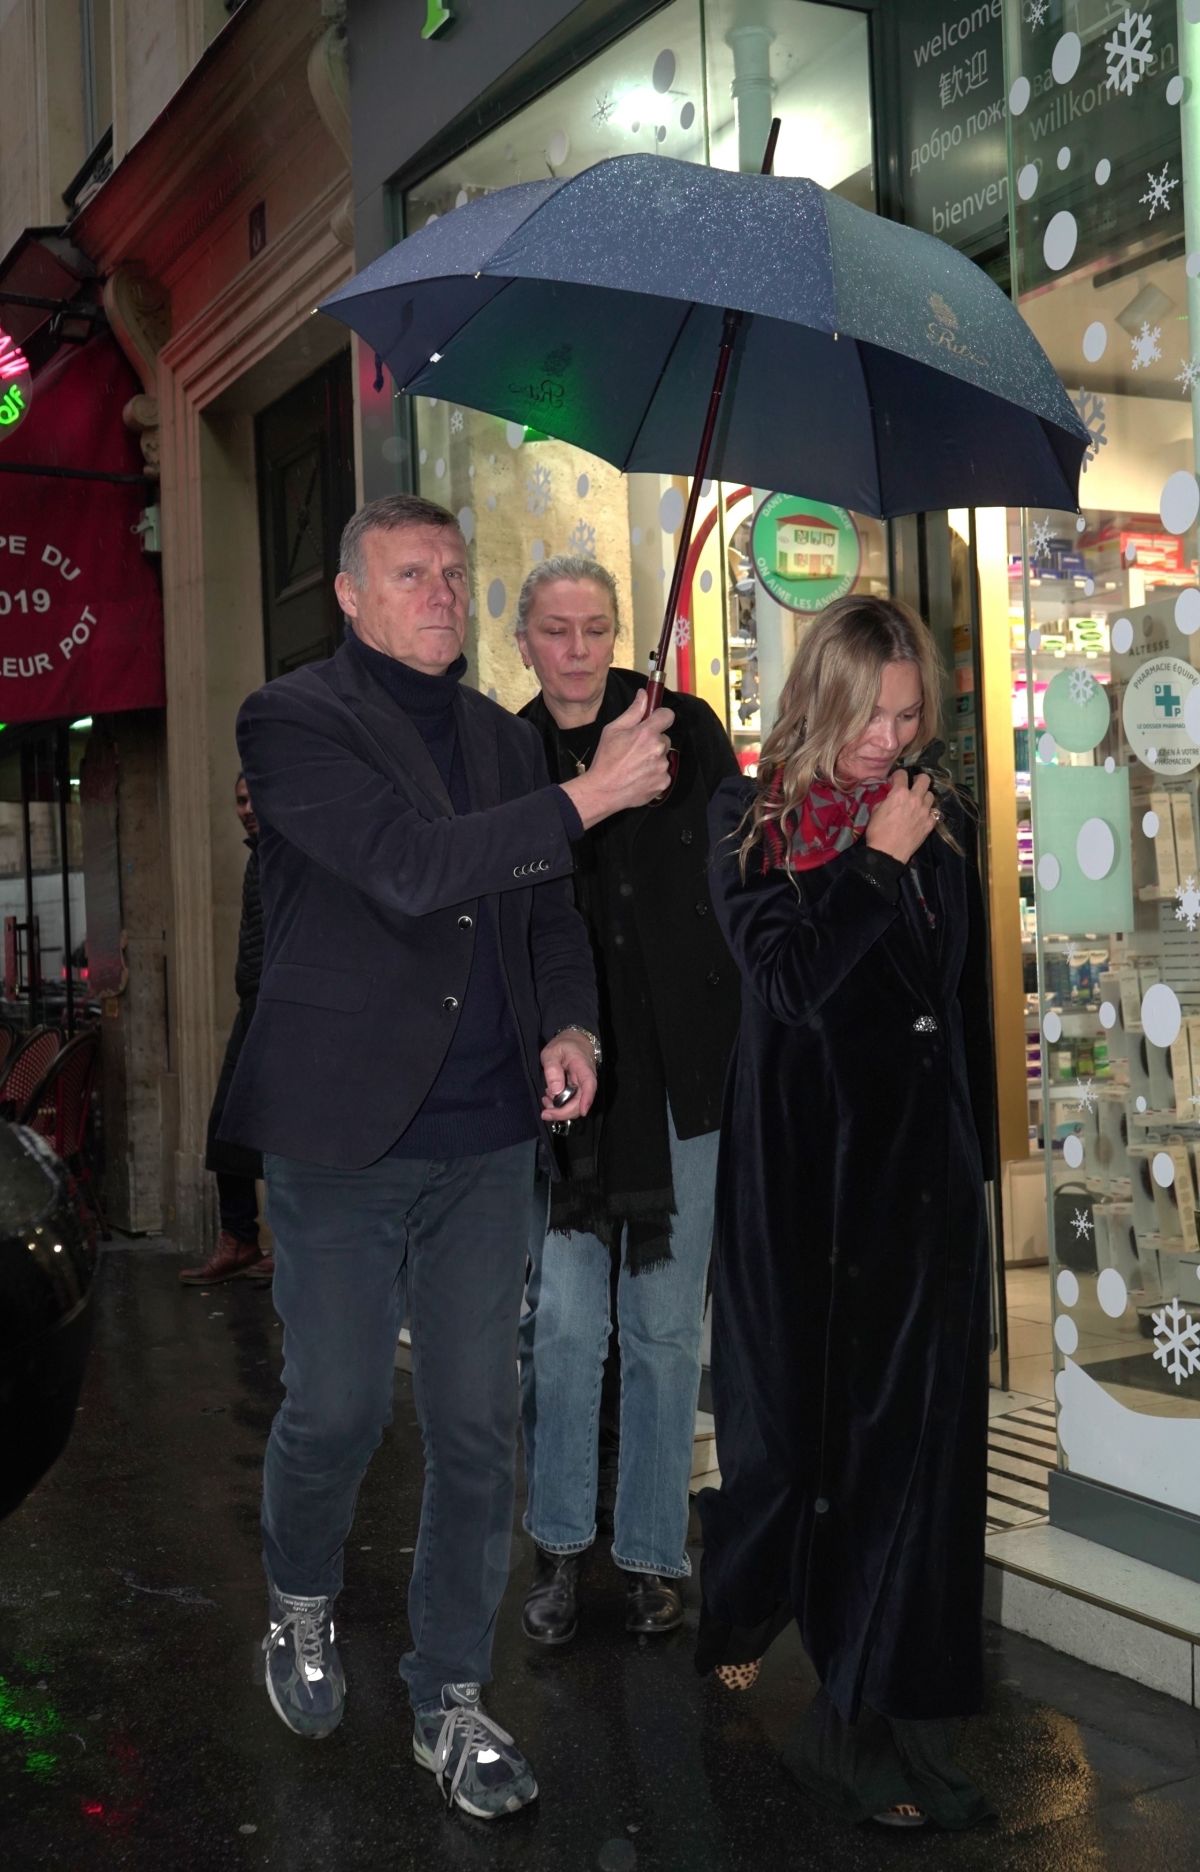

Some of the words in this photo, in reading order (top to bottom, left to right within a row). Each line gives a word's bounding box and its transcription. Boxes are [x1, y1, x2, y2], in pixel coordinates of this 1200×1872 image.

[914, 0, 1001, 68] welcome
[910, 127, 962, 177] добро
[41, 544, 82, 582] DU
[757, 556, 770, 578] ON
[768, 578, 792, 602] AIME
[794, 597, 812, 610] LES
[0, 653, 54, 678] EUR
[59, 605, 98, 660] POT
[1128, 639, 1170, 657] ALTESSE
[1133, 662, 1171, 689] PHARMACIE
[1155, 684, 1162, 694] D
[1174, 707, 1181, 717] P
